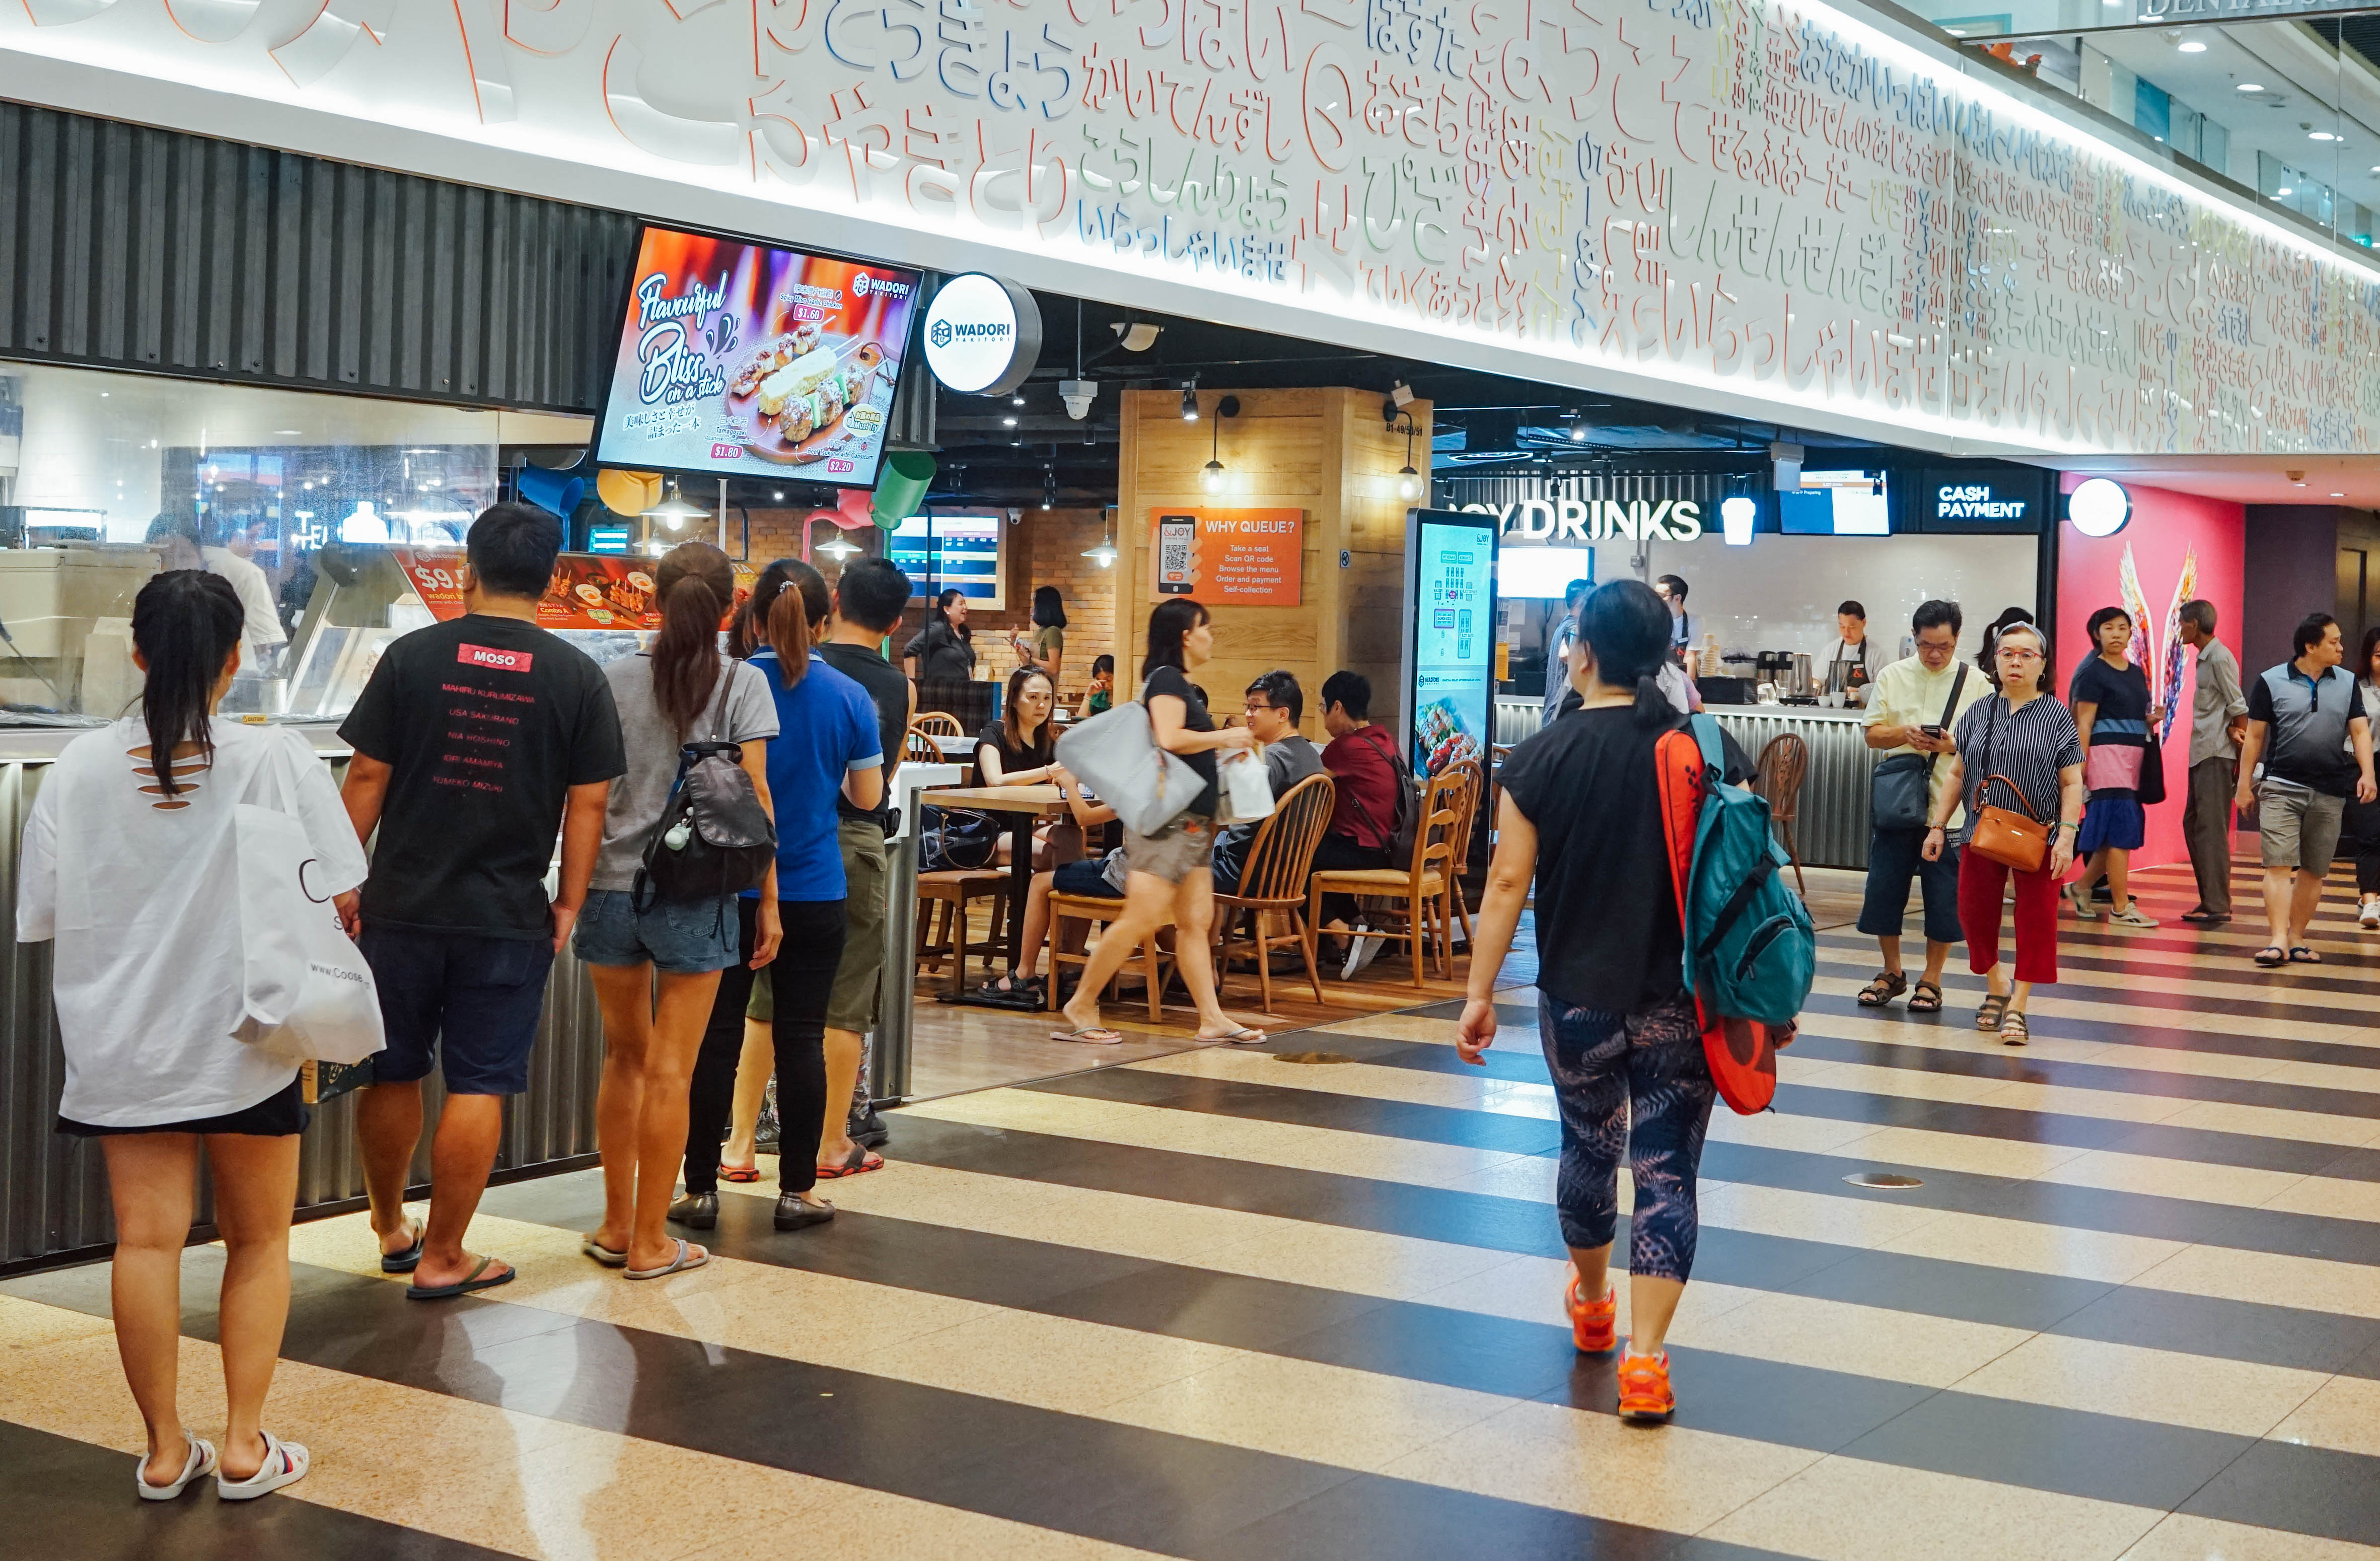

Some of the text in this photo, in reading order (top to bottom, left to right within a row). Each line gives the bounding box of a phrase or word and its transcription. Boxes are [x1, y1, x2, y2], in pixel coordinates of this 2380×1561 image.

[2147, 0, 2291, 15] DEN
[1078, 199, 1290, 286] いらっしゃいませ
[871, 279, 909, 295] WADORI
[637, 271, 728, 330] Flavourful
[779, 293, 842, 310] Spicy Miso Garlic Chicken
[870, 290, 907, 301] YAKITORI
[798, 309, 820, 320] $1.60
[955, 323, 1010, 336] WADORI
[1663, 269, 1946, 417] いらっしゃいませ
[638, 321, 704, 403] Bliss
[666, 366, 726, 403] on a stick
[716, 427, 747, 437] Tamagoyaki
[854, 421, 879, 433] Must Try
[715, 446, 739, 458] $1.80
[807, 448, 819, 456] Beef
[820, 450, 839, 458] Tsukune
[830, 461, 851, 472] $2.20
[1939, 486, 1989, 502] CASH
[1938, 502, 2025, 518] PAYMENT
[1205, 520, 1295, 534] WHY QUEUE?
[1524, 500, 1702, 541] DRINKS
[1164, 526, 1191, 536] &JOY
[1476, 533, 1489, 542] &JOY
[1230, 544, 1246, 552] Take
[1244, 555, 1255, 563] QR
[1219, 564, 1244, 573] Browse
[1246, 565, 1258, 573] the
[1216, 575, 1281, 585] Order and payment
[1224, 585, 1273, 594] Self-collection
[473, 650, 516, 666] MOSO
[442, 683, 535, 703] MAHIRU KURUMIZAWA
[449, 708, 468, 717] USA
[447, 731, 511, 747] NIA HOSHINO
[472, 780, 503, 793] MIZUKI
